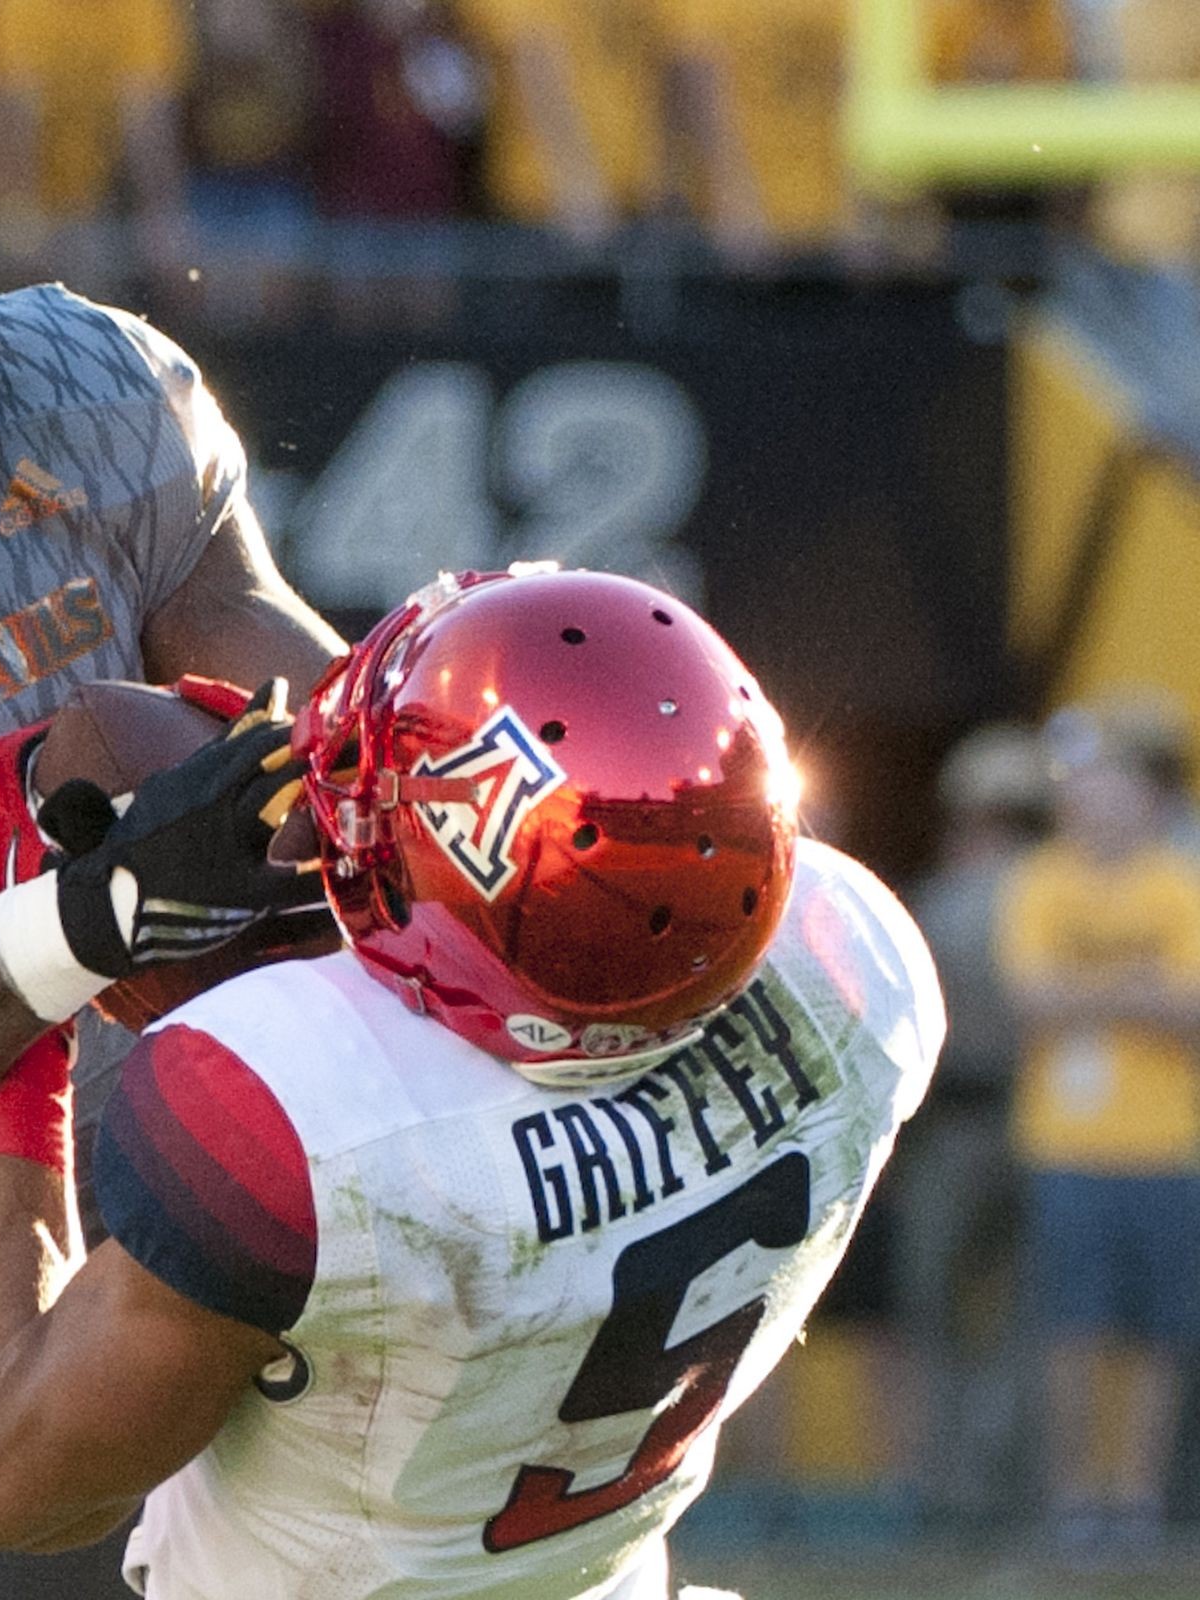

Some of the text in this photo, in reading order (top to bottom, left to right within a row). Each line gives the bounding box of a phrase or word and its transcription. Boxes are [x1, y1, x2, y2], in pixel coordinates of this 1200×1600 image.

[408, 704, 569, 903] A
[512, 978, 821, 1243] GRIFFEY
[482, 1150, 811, 1555] 5
